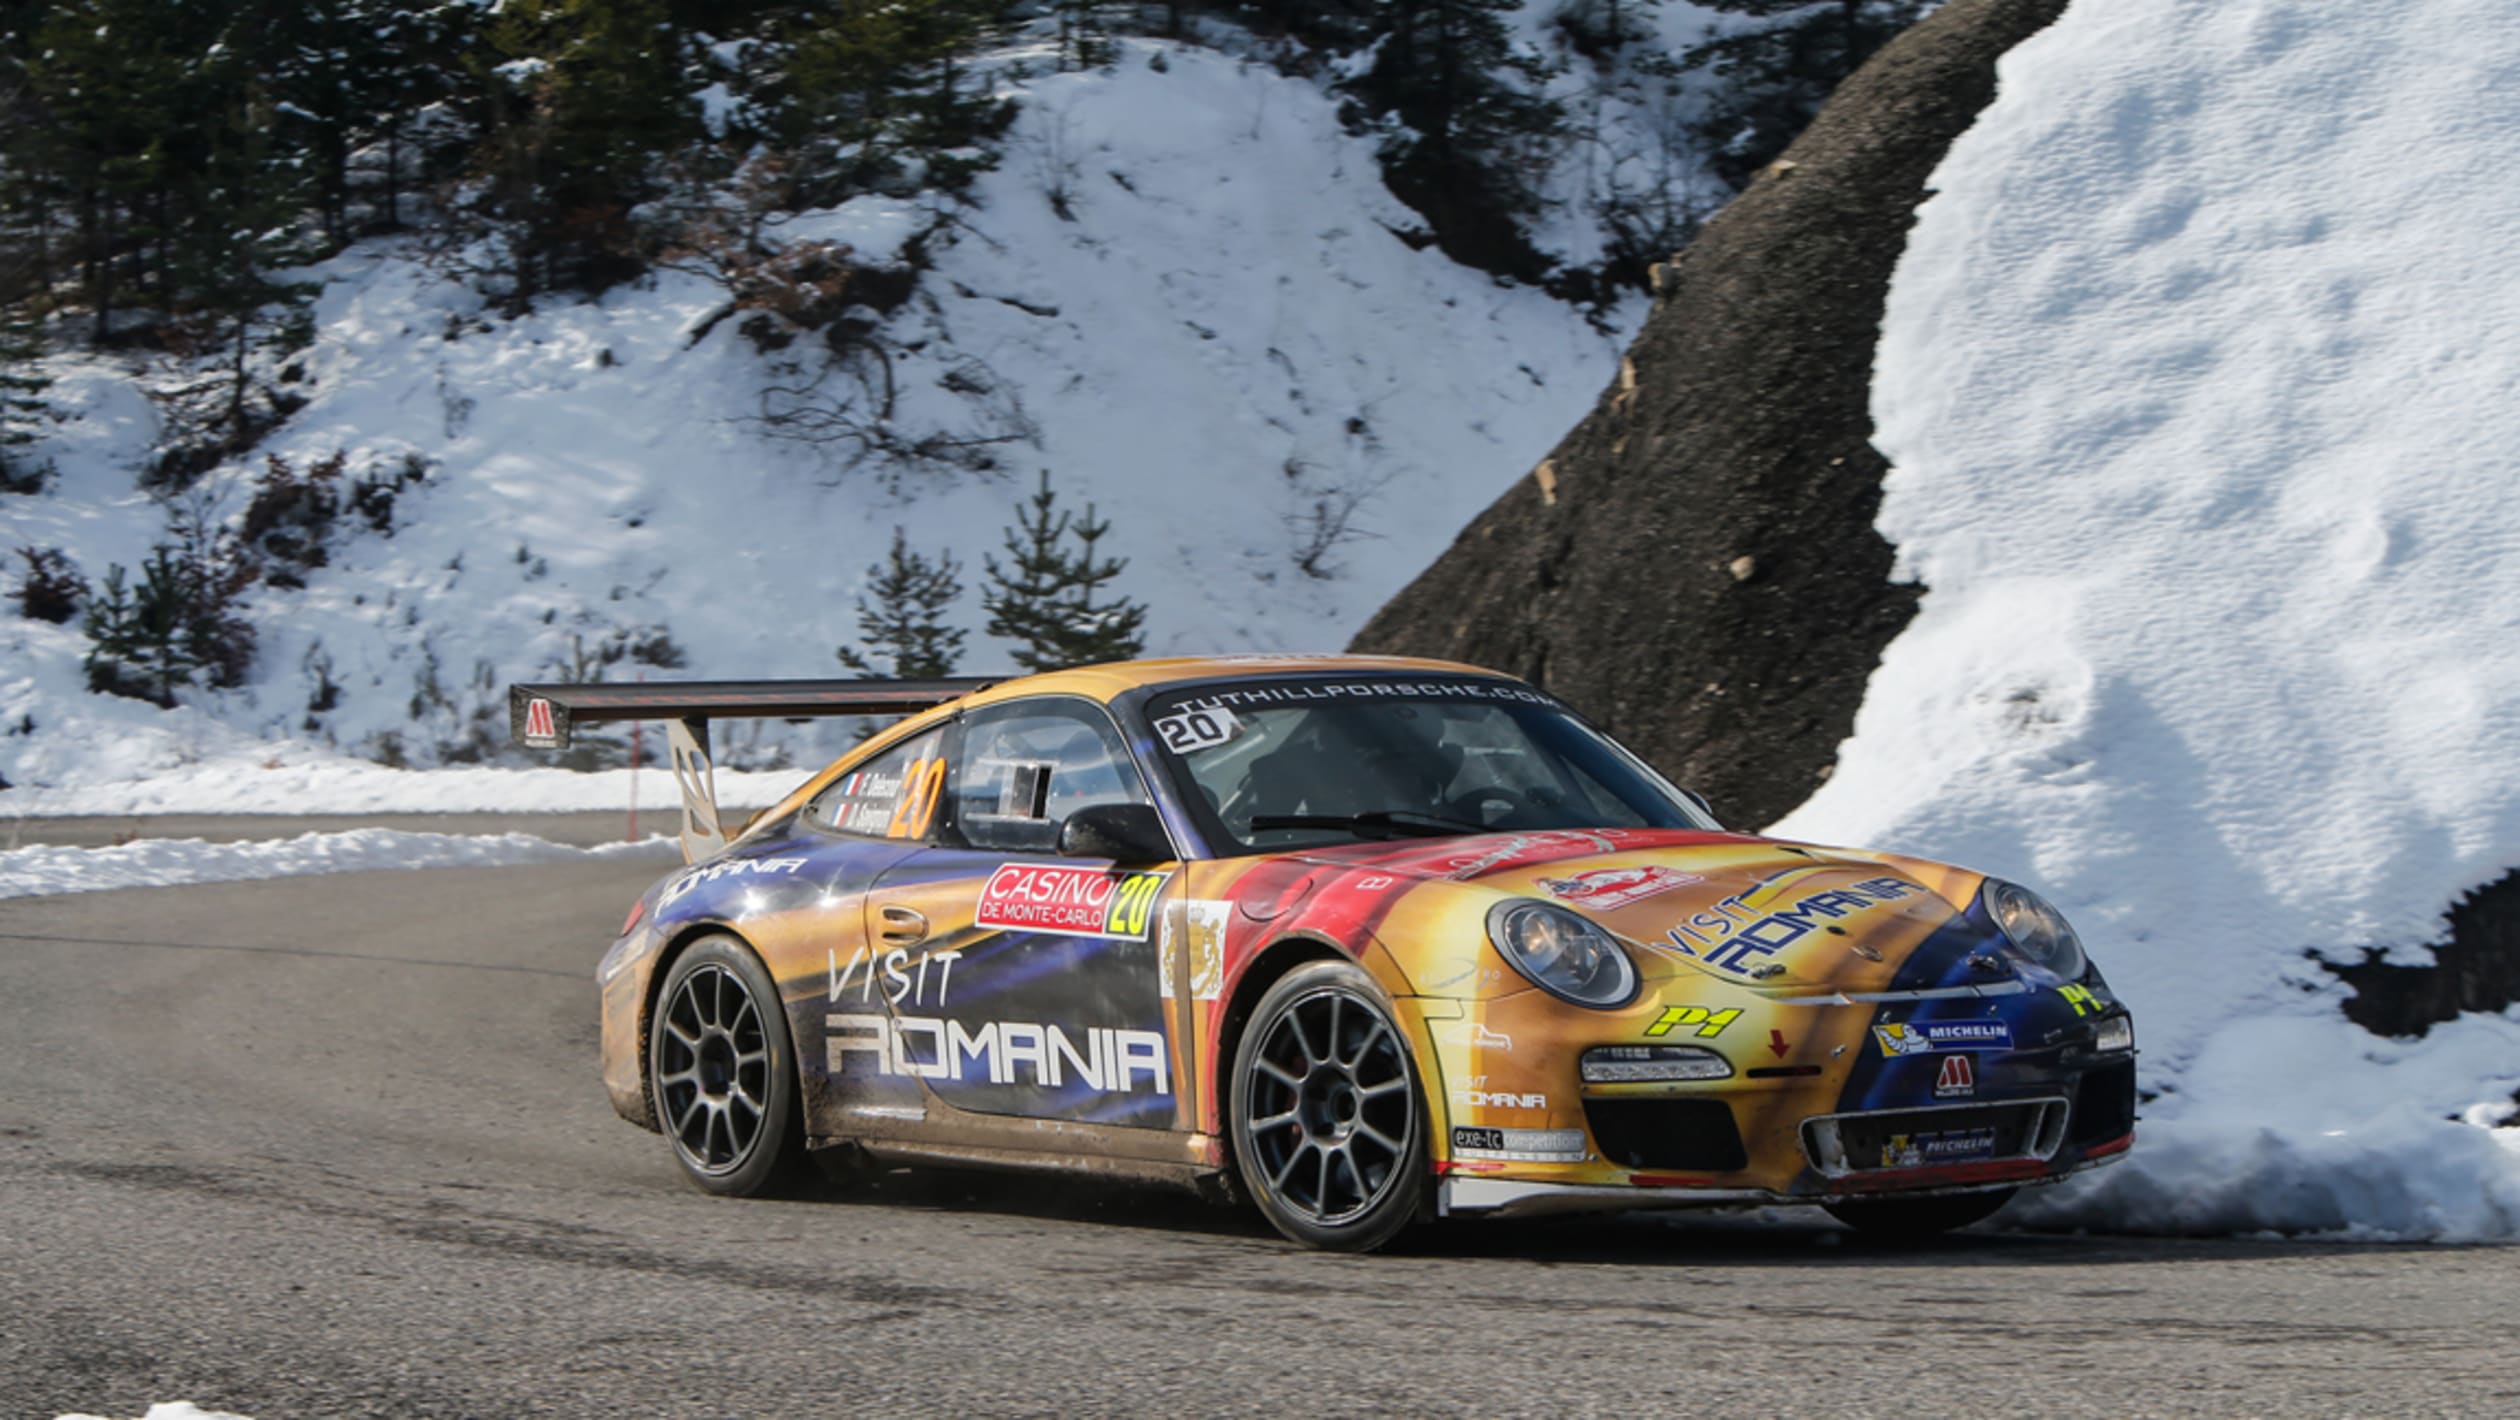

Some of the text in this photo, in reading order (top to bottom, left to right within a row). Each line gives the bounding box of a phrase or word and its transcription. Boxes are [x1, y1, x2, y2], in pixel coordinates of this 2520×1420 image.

[1172, 684, 1561, 715] TUTHILLPORSCHE.COM
[1159, 713, 1224, 749] 20
[887, 757, 947, 839] 20
[990, 868, 1115, 906] CASINO
[1109, 874, 1161, 935] 20
[981, 902, 1102, 927] DE MONTE-CARLO
[1651, 894, 1760, 957] VISIT
[1702, 876, 1928, 975] ROMANIA
[829, 947, 963, 1008] VISIT
[1643, 1005, 1745, 1038] P1
[1929, 1025, 2008, 1038] MICHELIN
[825, 1013, 1169, 1095] ROMANIA
[1451, 1091, 1546, 1110] ROMANIA
[1456, 1130, 1501, 1149] exe-tc
[1926, 1137, 1993, 1154] MICHELIN
